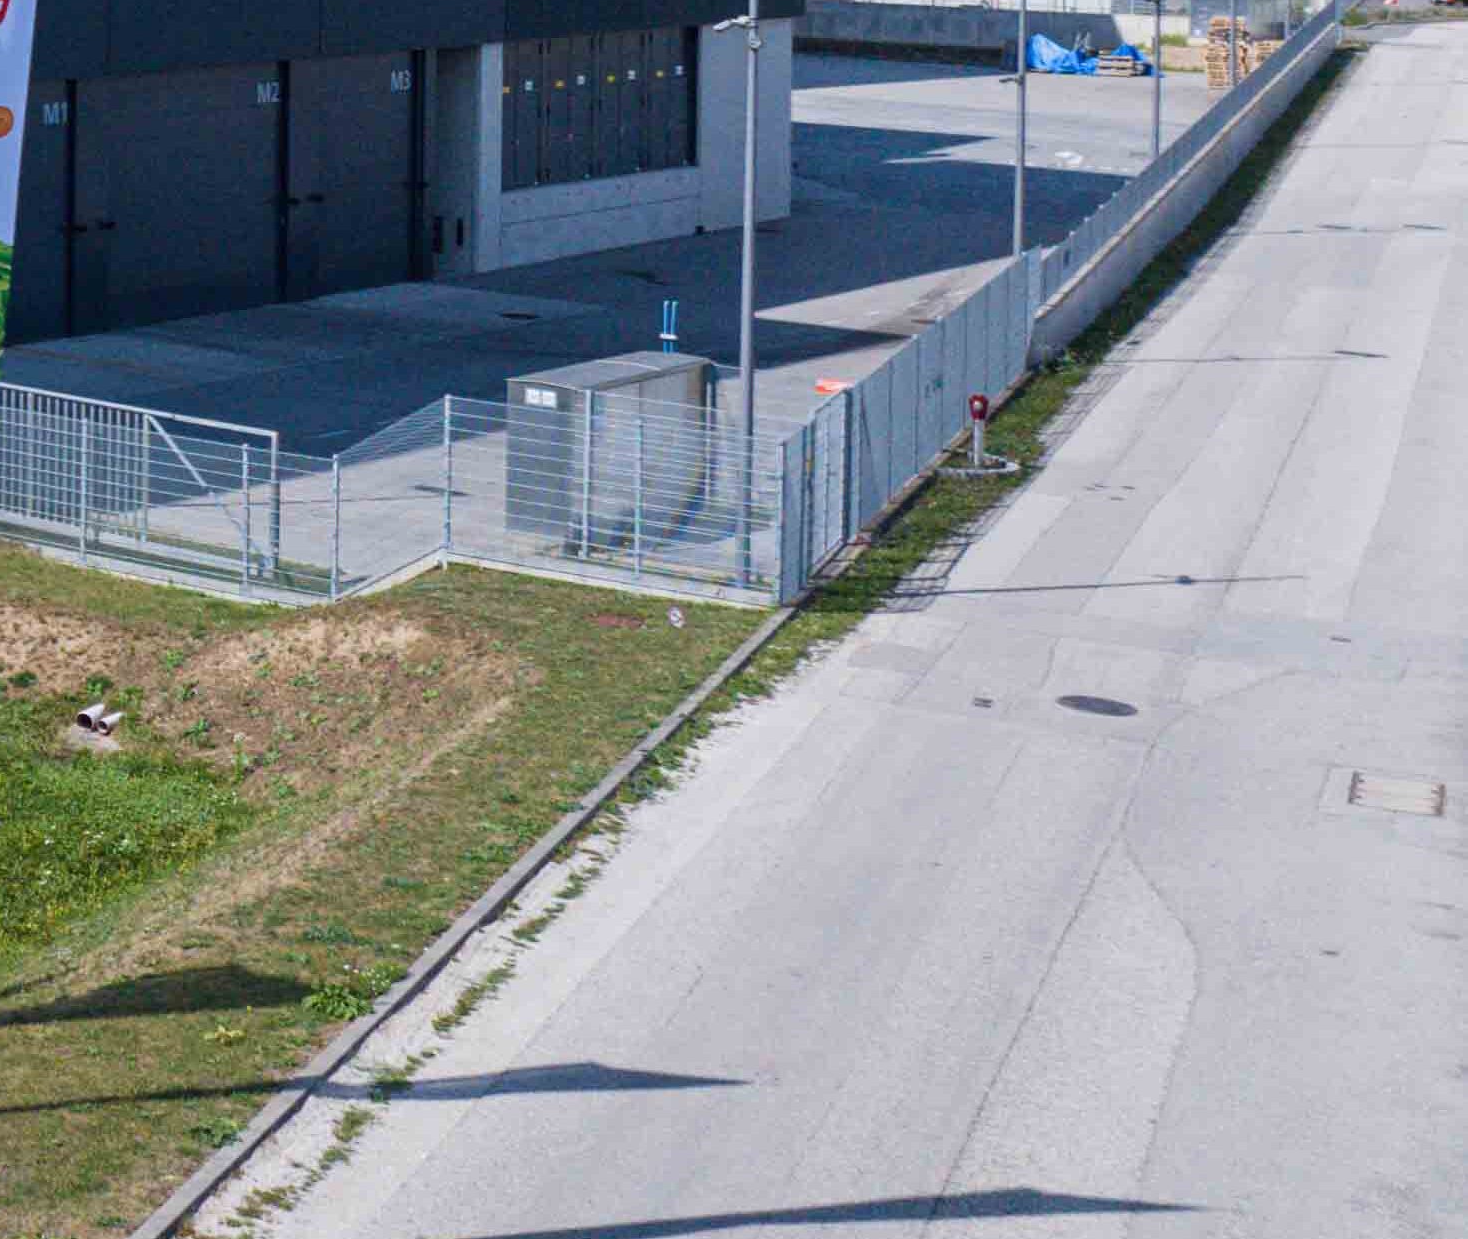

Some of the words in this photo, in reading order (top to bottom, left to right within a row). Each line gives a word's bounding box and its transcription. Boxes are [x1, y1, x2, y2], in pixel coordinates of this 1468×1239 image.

[255, 81, 280, 103] M2
[390, 70, 412, 94] M3
[43, 101, 68, 125] M1
